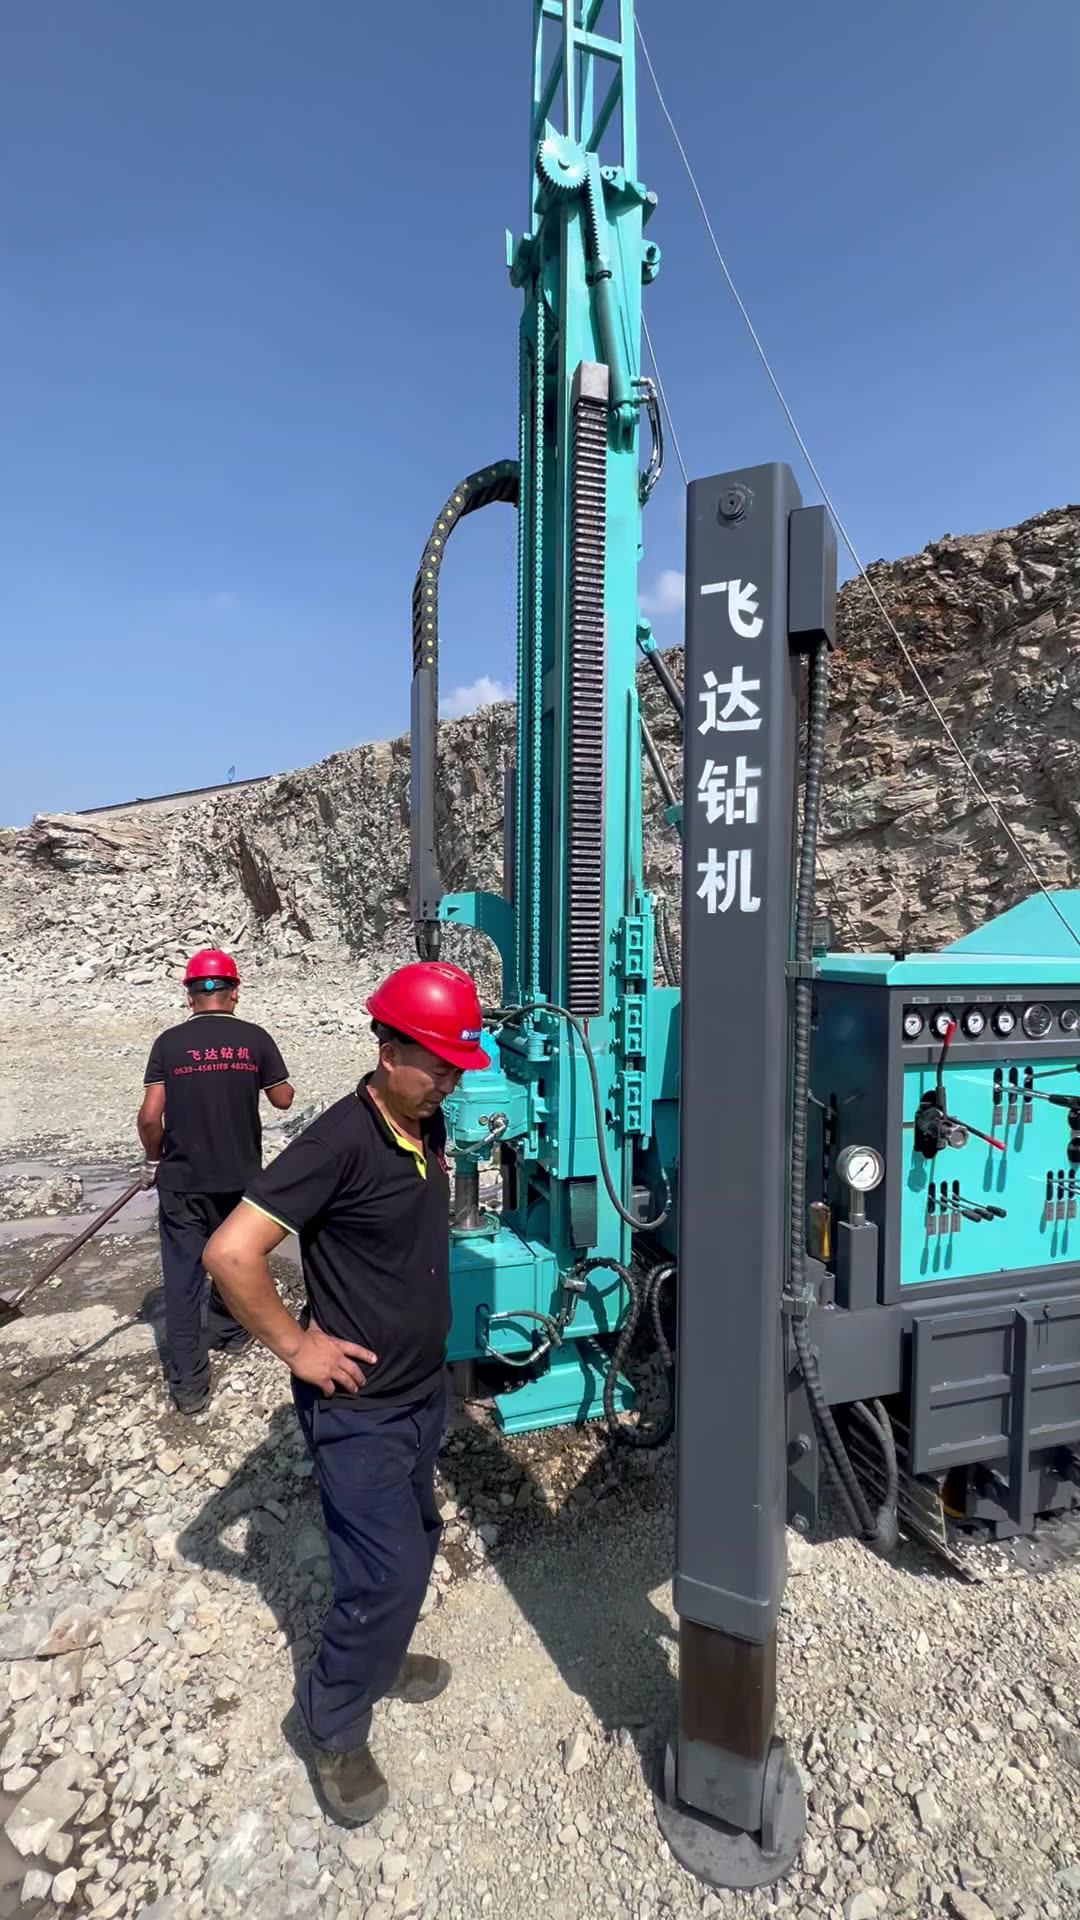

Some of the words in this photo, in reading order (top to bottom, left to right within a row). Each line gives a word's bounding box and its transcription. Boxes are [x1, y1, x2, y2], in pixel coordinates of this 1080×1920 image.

[697, 579, 763, 914] 飞达钻机
[187, 1046, 250, 1061] 飞达钻机
